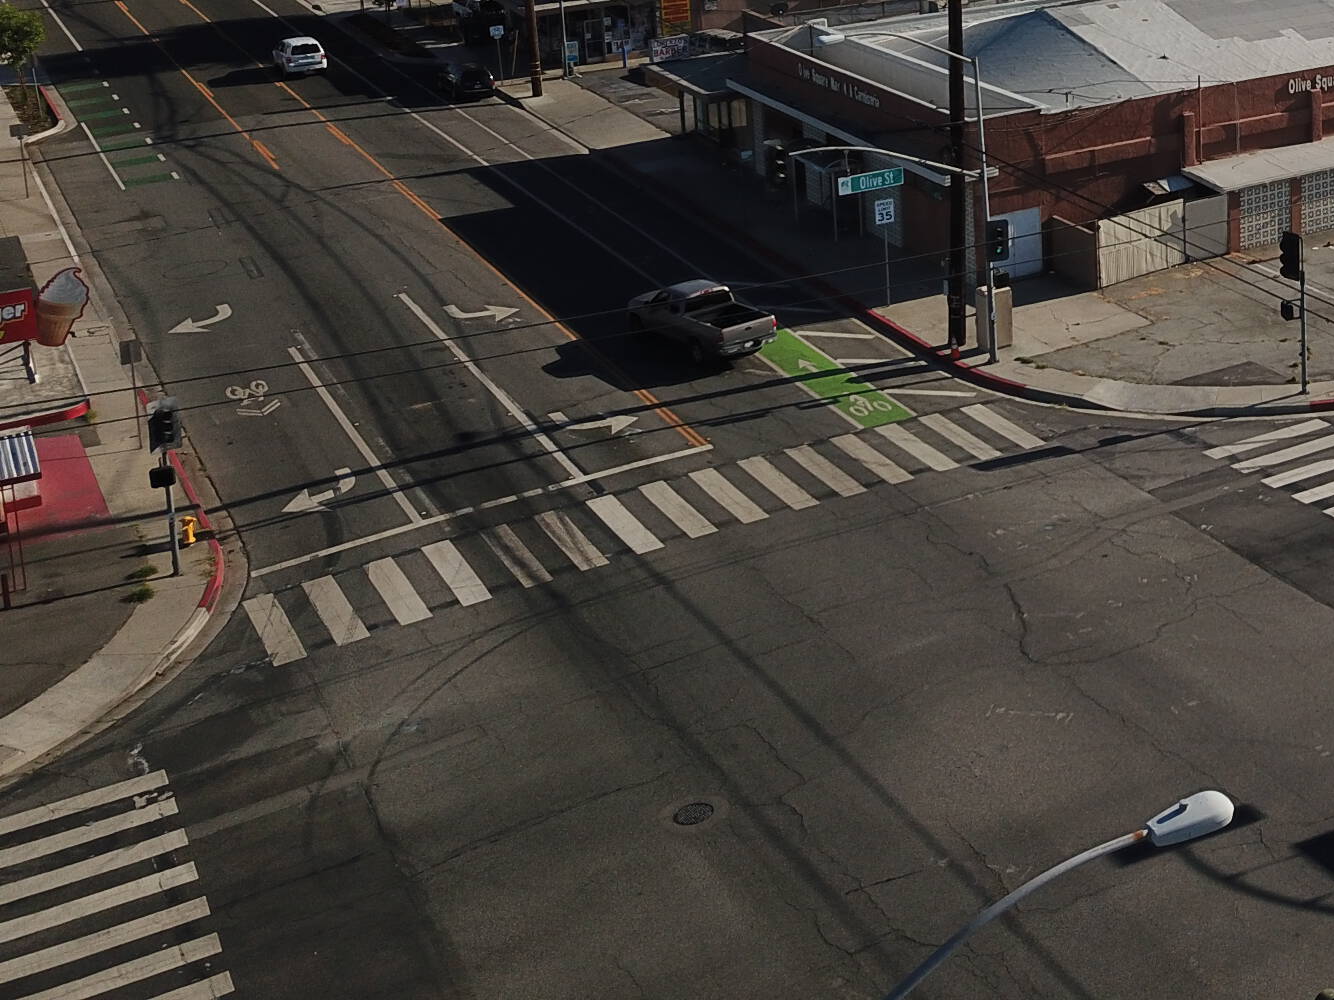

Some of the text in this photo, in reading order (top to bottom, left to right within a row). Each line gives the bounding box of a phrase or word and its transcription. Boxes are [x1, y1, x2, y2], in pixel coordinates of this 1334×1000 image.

[1288, 78, 1312, 94] Olive
[859, 171, 894, 190] Olive St
[877, 211, 893, 222] 35
